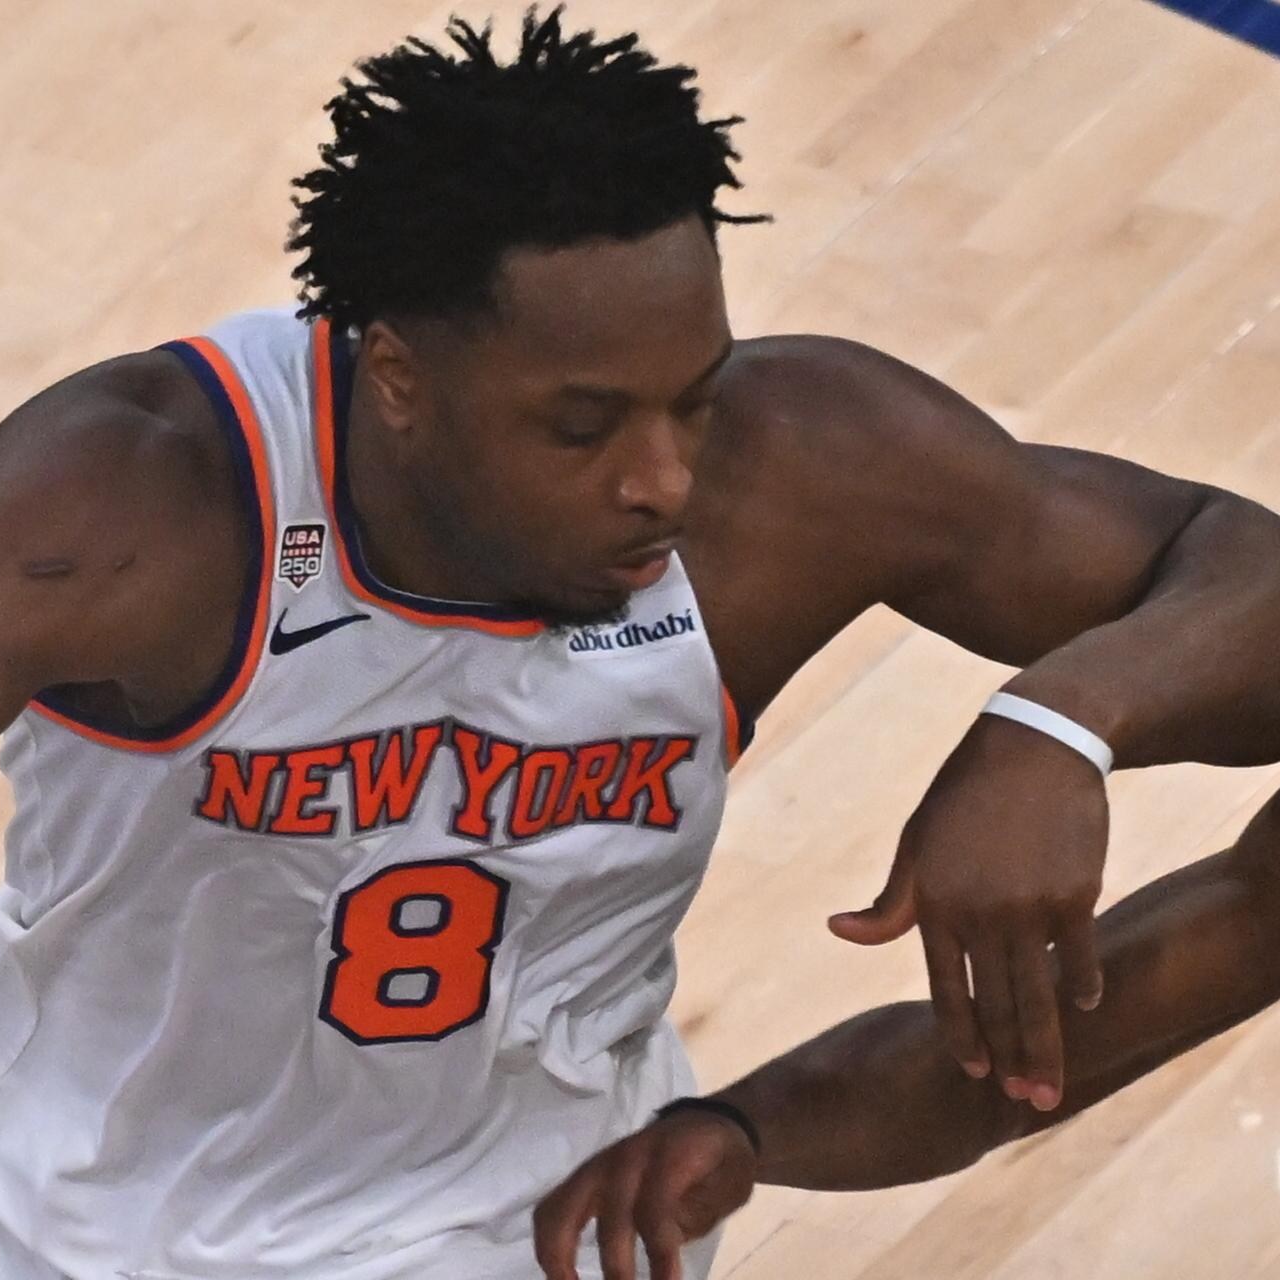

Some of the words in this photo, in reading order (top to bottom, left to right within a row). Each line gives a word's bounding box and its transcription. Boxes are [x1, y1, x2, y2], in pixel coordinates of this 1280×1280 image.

[285, 530, 320, 546] USA
[281, 557, 320, 575] 250
[569, 631, 613, 652] abu
[616, 608, 696, 649] dhabi
[193, 717, 448, 838] NEW
[446, 715, 700, 845] YORK
[318, 858, 512, 1046] 8
